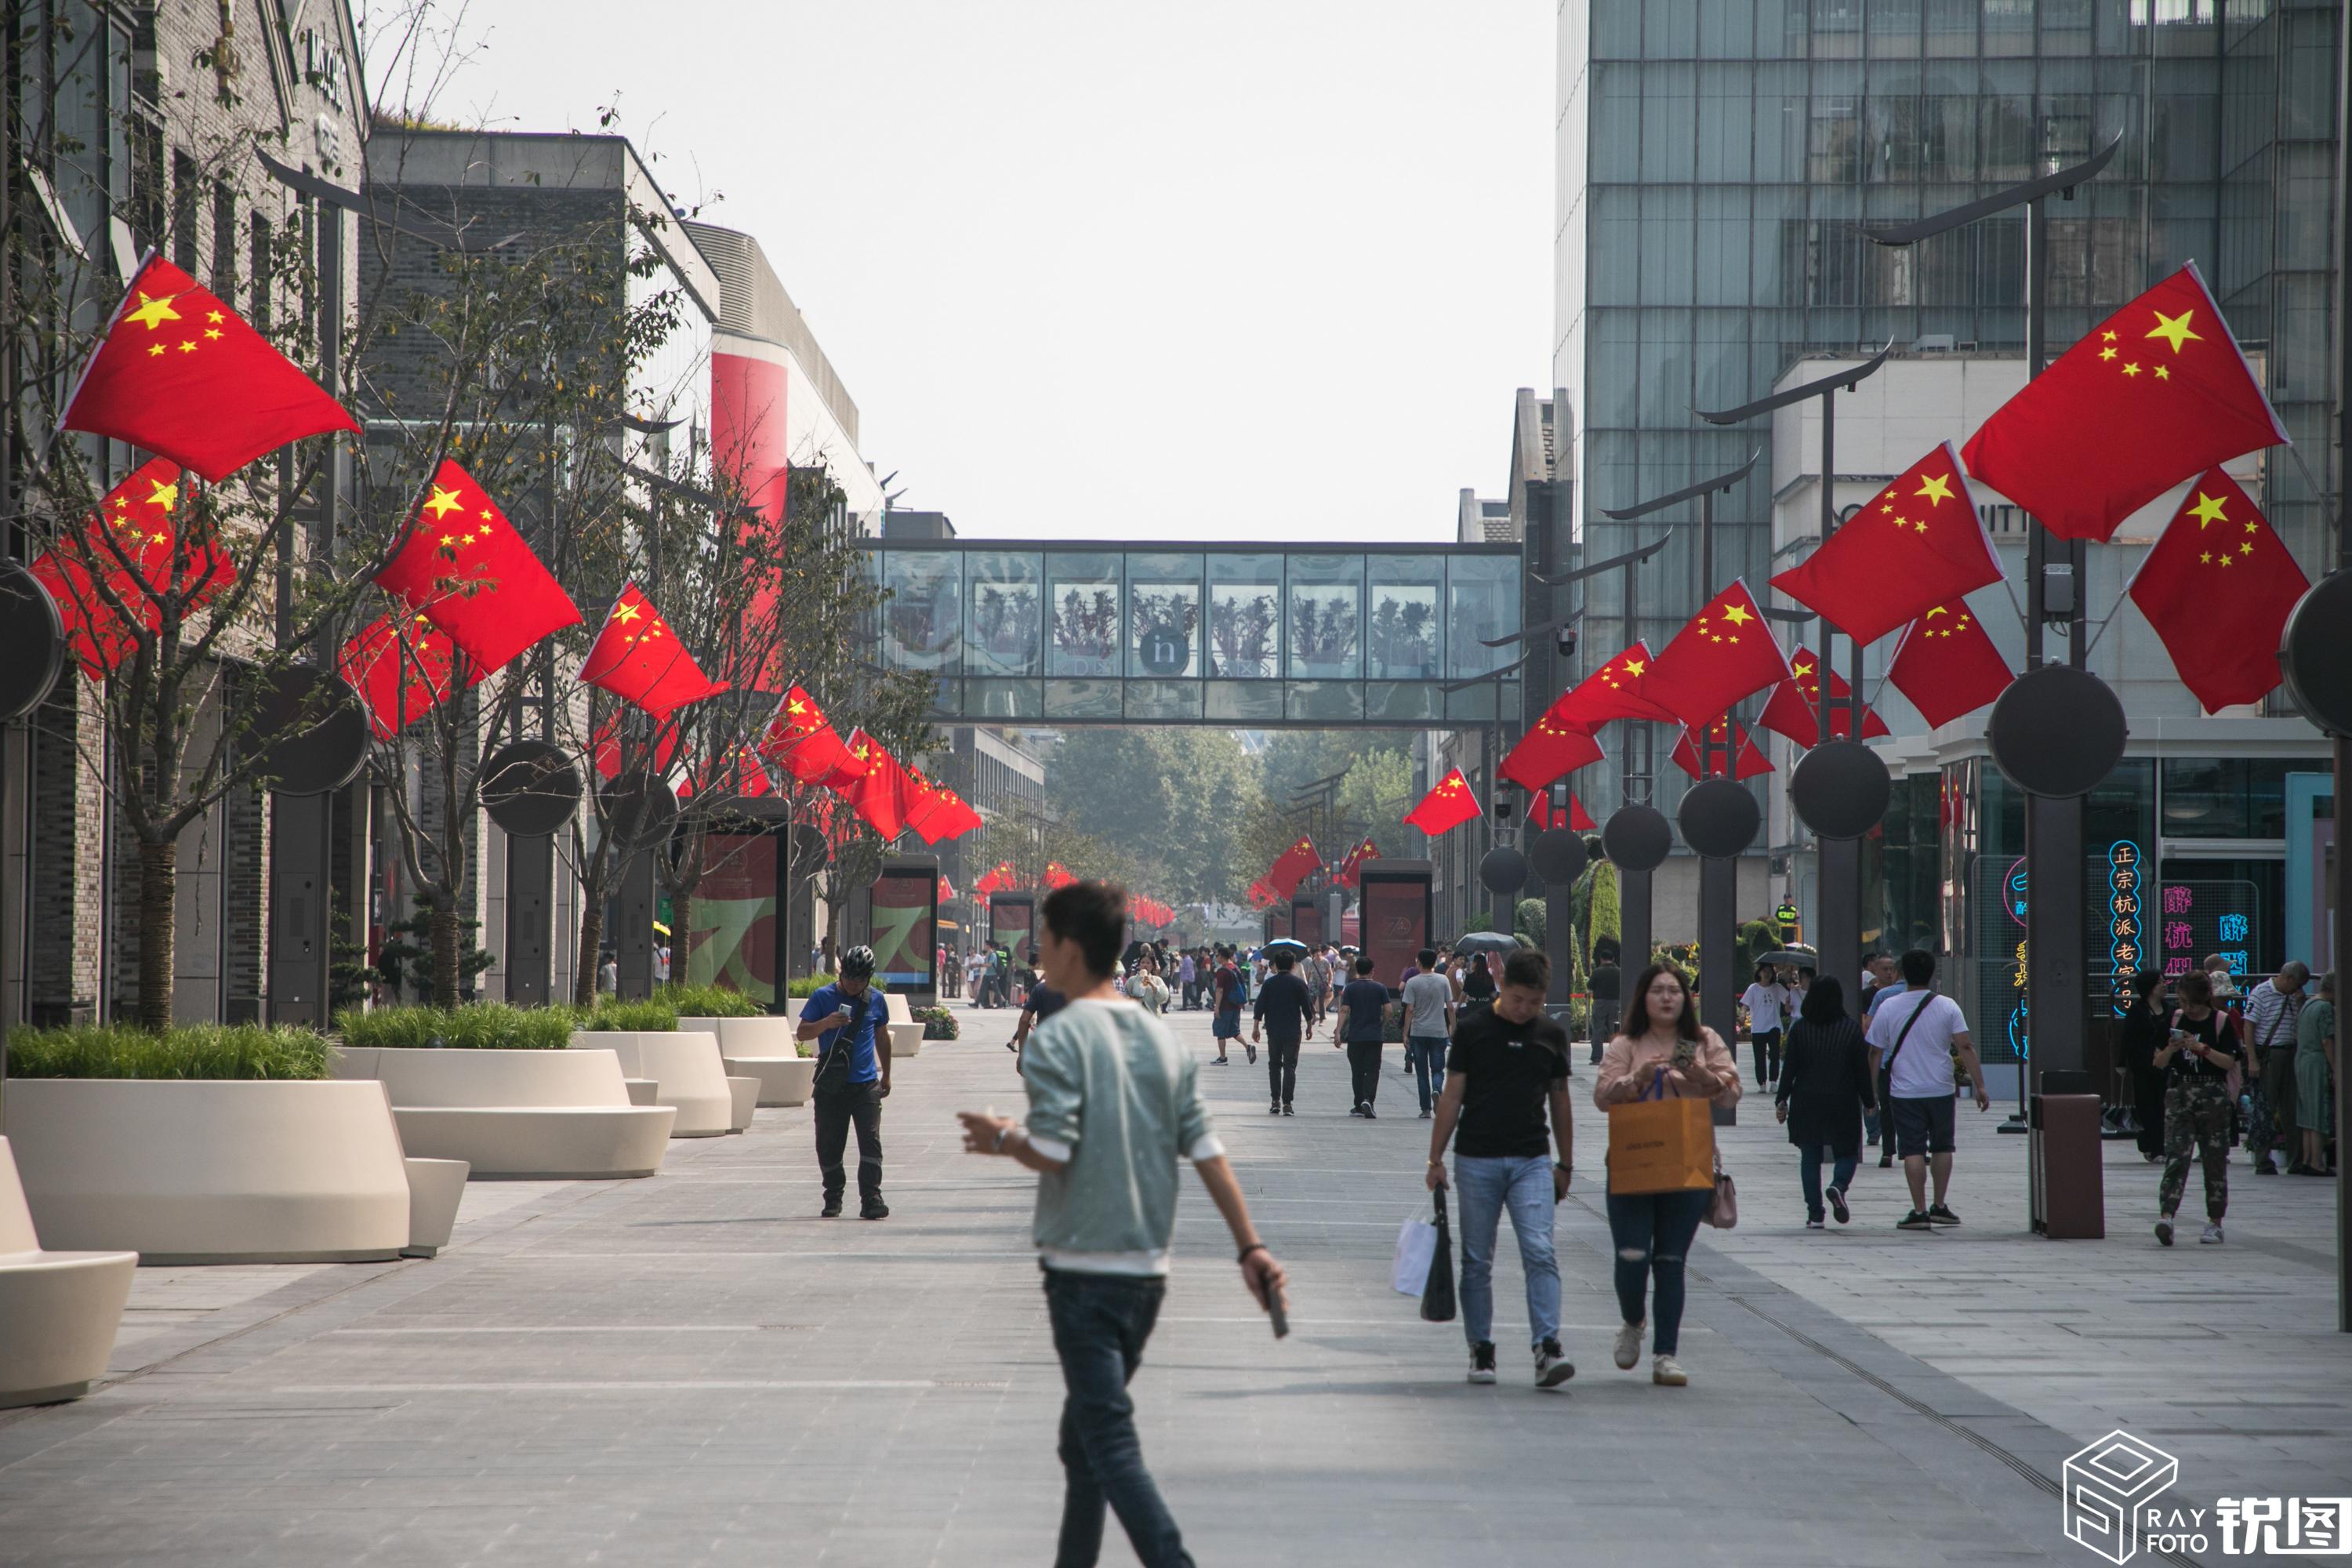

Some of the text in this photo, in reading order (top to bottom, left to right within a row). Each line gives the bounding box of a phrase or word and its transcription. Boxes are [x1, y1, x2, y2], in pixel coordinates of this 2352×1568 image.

[2114, 847, 2136, 1009] 正宗杭派老字号
